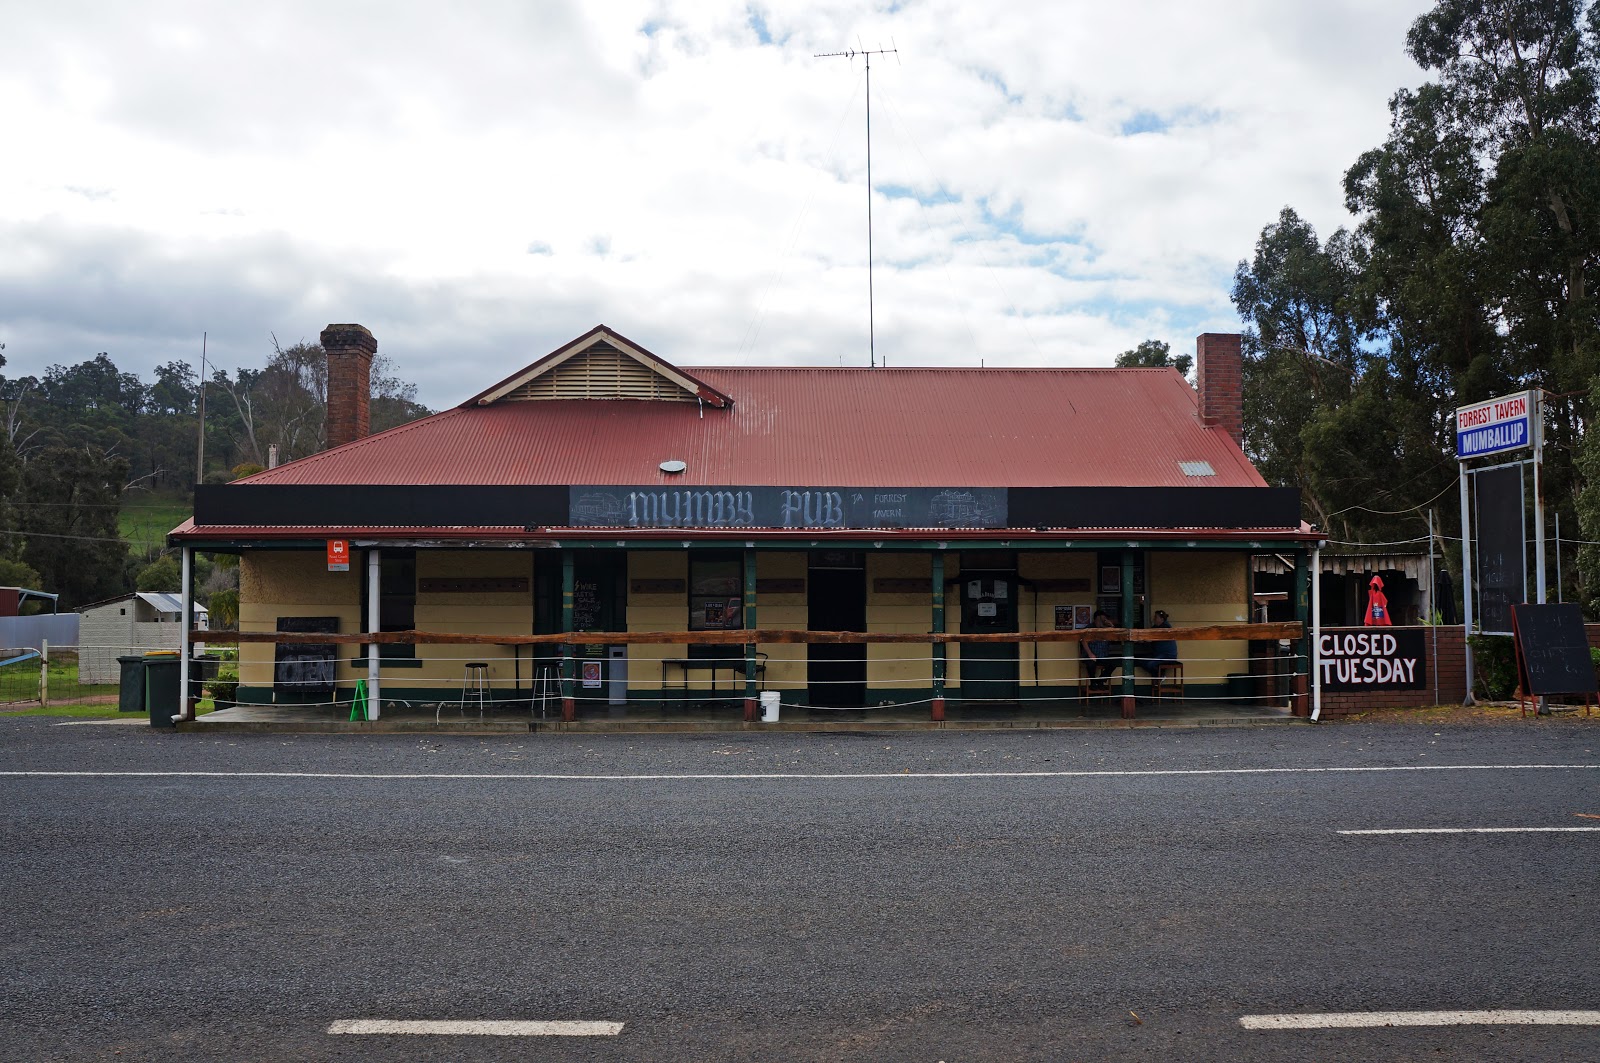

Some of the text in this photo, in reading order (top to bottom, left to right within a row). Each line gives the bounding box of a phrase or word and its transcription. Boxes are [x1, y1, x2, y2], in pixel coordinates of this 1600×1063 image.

[1459, 397, 1526, 428] FORREST TAVERN
[1462, 421, 1524, 453] MUMBALLUP
[781, 489, 843, 527] PUB
[874, 493, 907, 504] FORREST
[1320, 633, 1397, 656] CLOSED
[1320, 657, 1417, 684] TUESDAY
